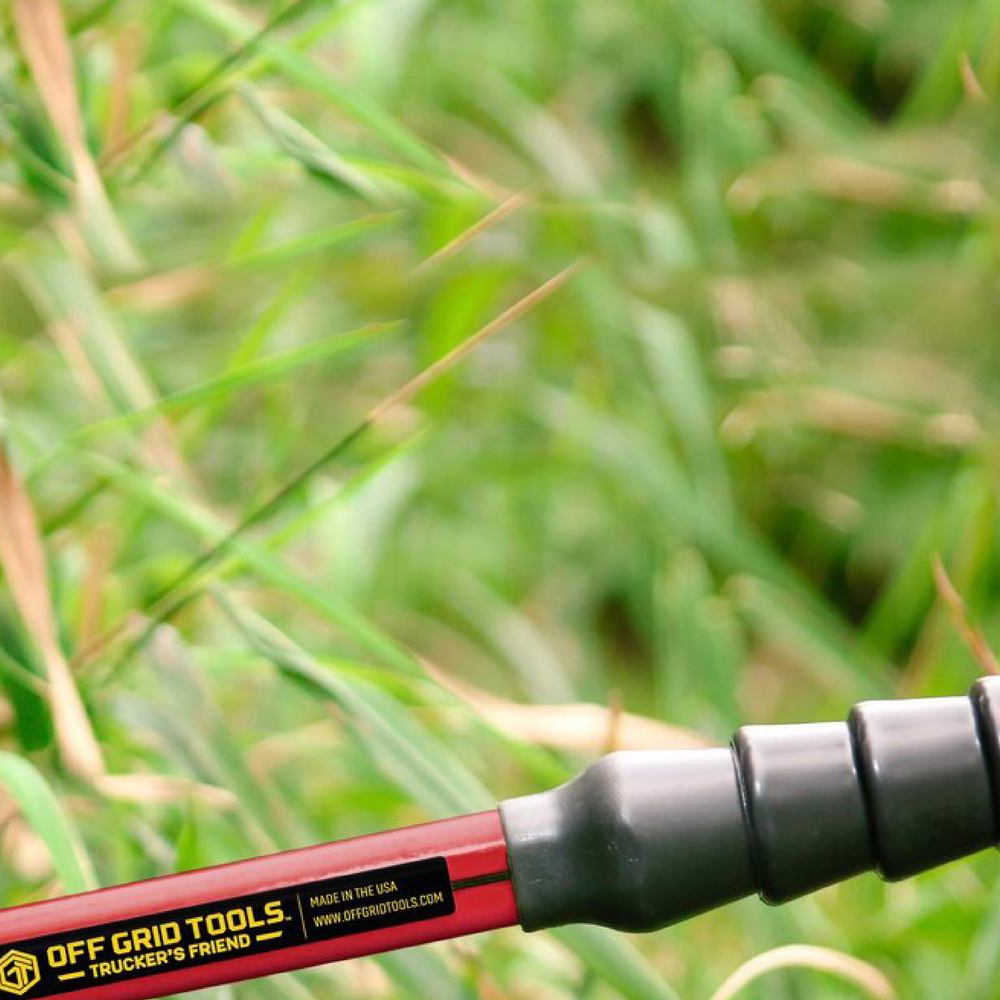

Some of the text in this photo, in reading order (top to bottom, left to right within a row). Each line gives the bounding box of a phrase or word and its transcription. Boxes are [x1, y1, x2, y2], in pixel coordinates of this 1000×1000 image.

[310, 880, 399, 908] MADE IN THE USA
[313, 891, 445, 928] WWW.OFFGRIDTOOLS.COM
[47, 900, 284, 968] OFF GRID TOOLS
[89, 933, 251, 978] TRUCKER'S FRIEND
